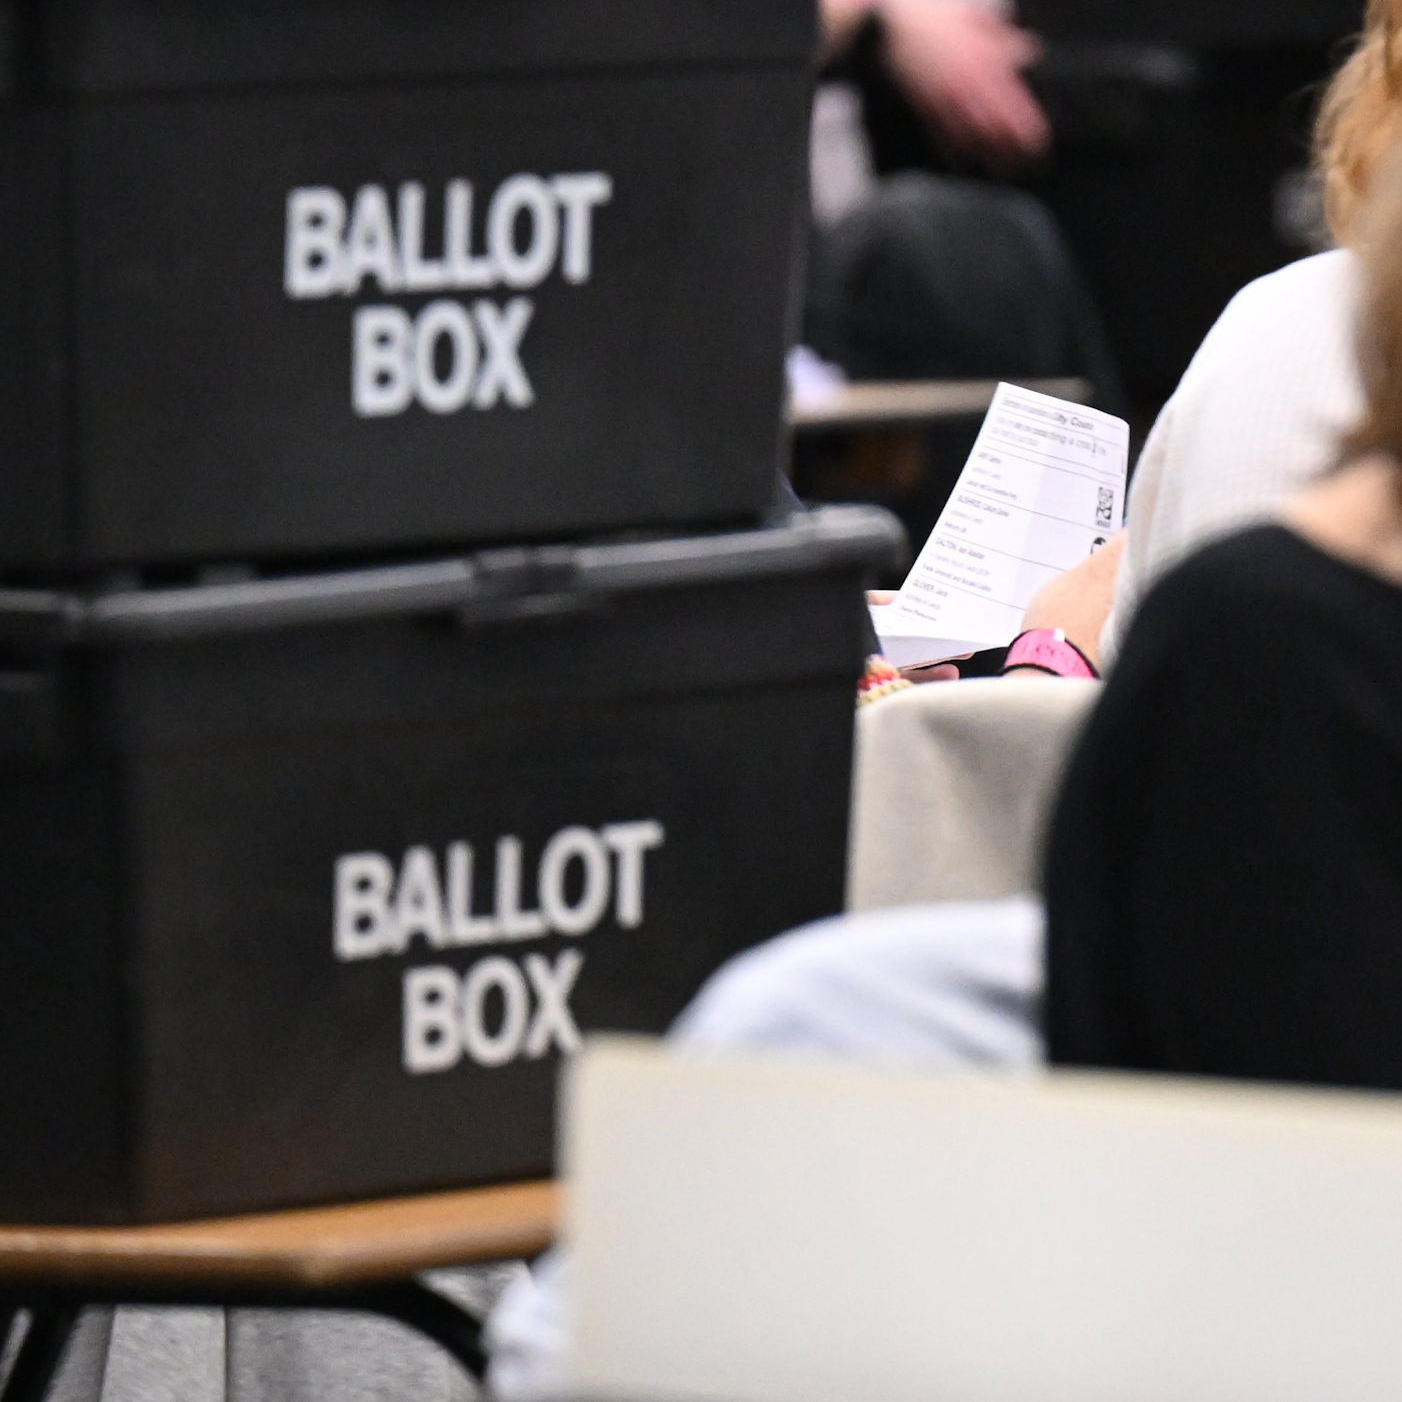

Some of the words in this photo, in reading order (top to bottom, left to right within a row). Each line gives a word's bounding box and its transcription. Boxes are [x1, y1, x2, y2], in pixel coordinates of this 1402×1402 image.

[283, 173, 612, 300] BALLOT
[351, 300, 536, 419] BOX
[332, 820, 663, 962] BALLOT
[402, 951, 584, 1076] BOX
